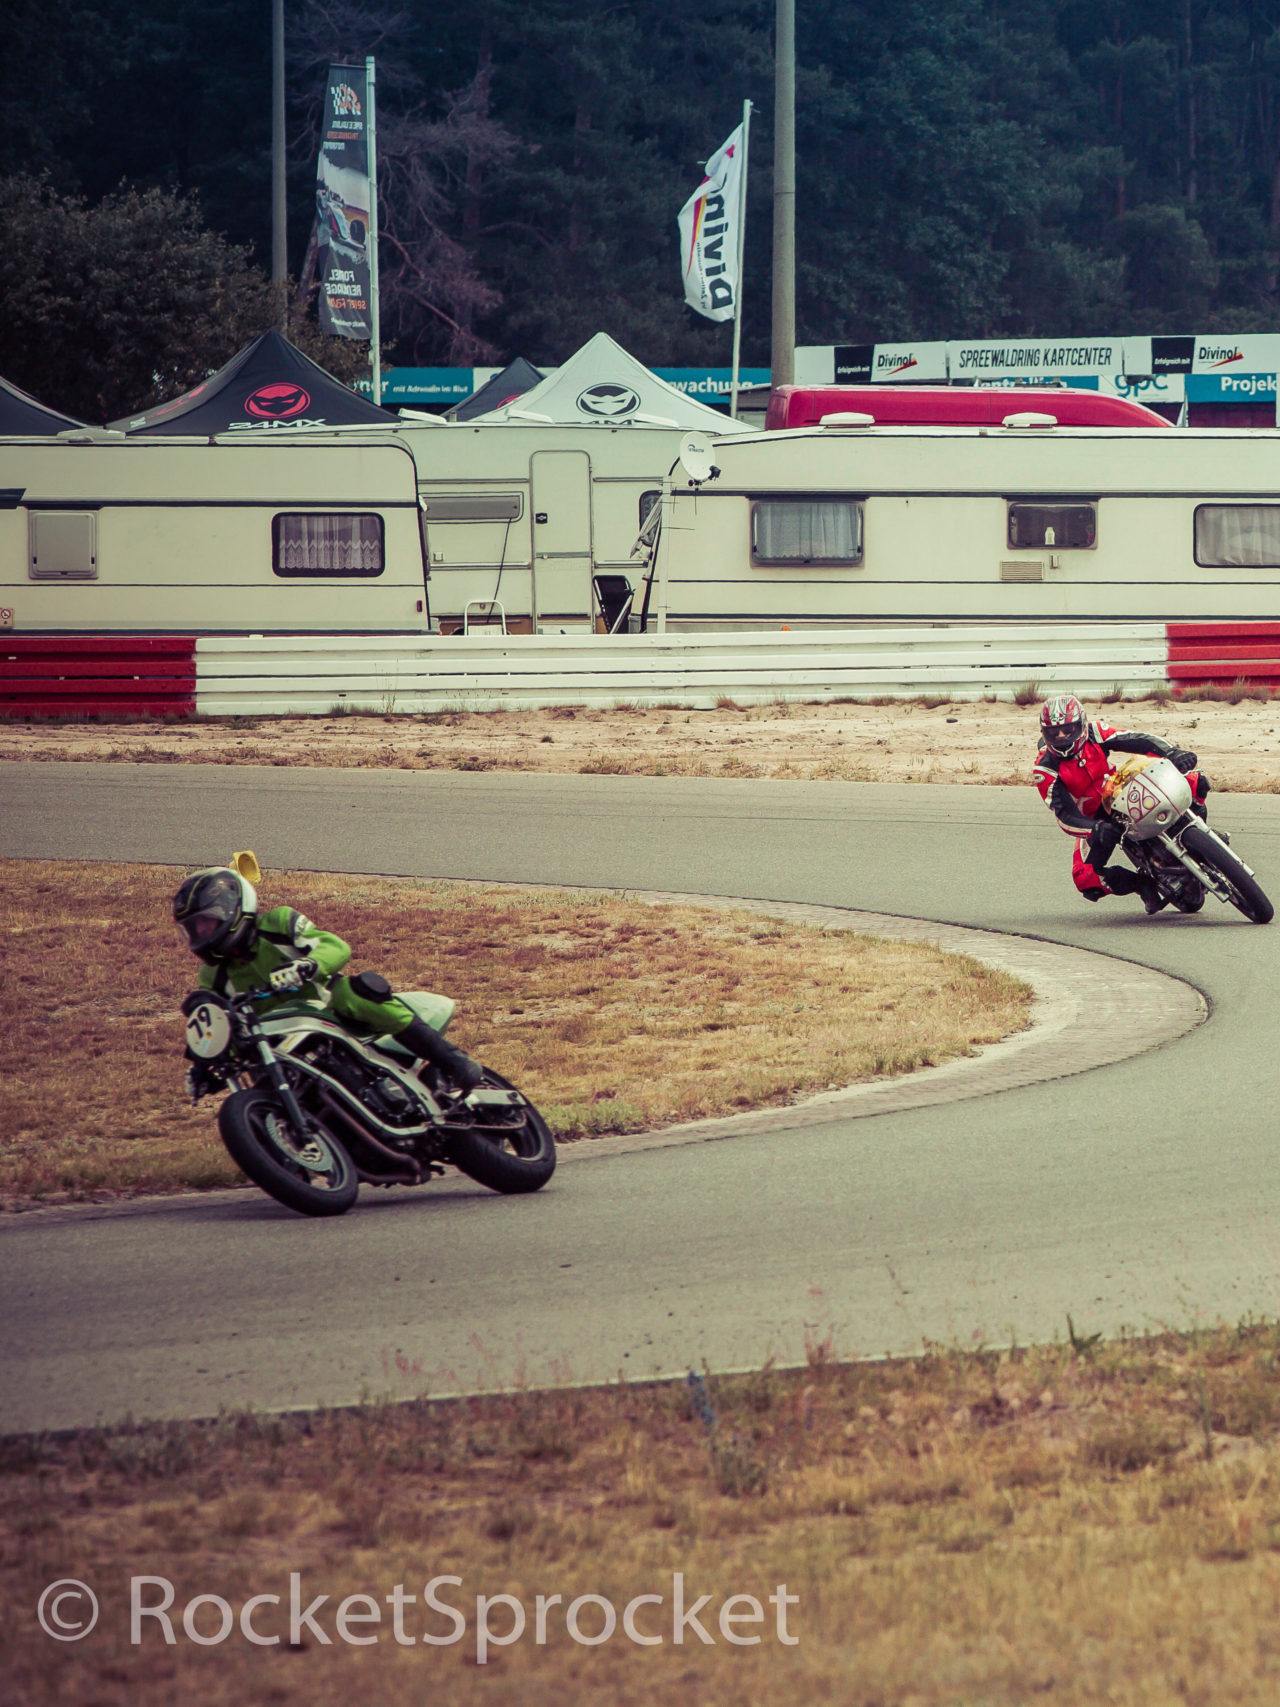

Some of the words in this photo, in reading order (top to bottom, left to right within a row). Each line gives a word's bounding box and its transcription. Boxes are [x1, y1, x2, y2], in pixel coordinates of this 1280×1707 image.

[877, 353, 914, 368] Divinol
[959, 349, 1040, 368] SPREEWALDRING
[1042, 347, 1113, 367] KARTCENTER
[1198, 346, 1239, 361] Divinol
[187, 1006, 211, 1039] 79
